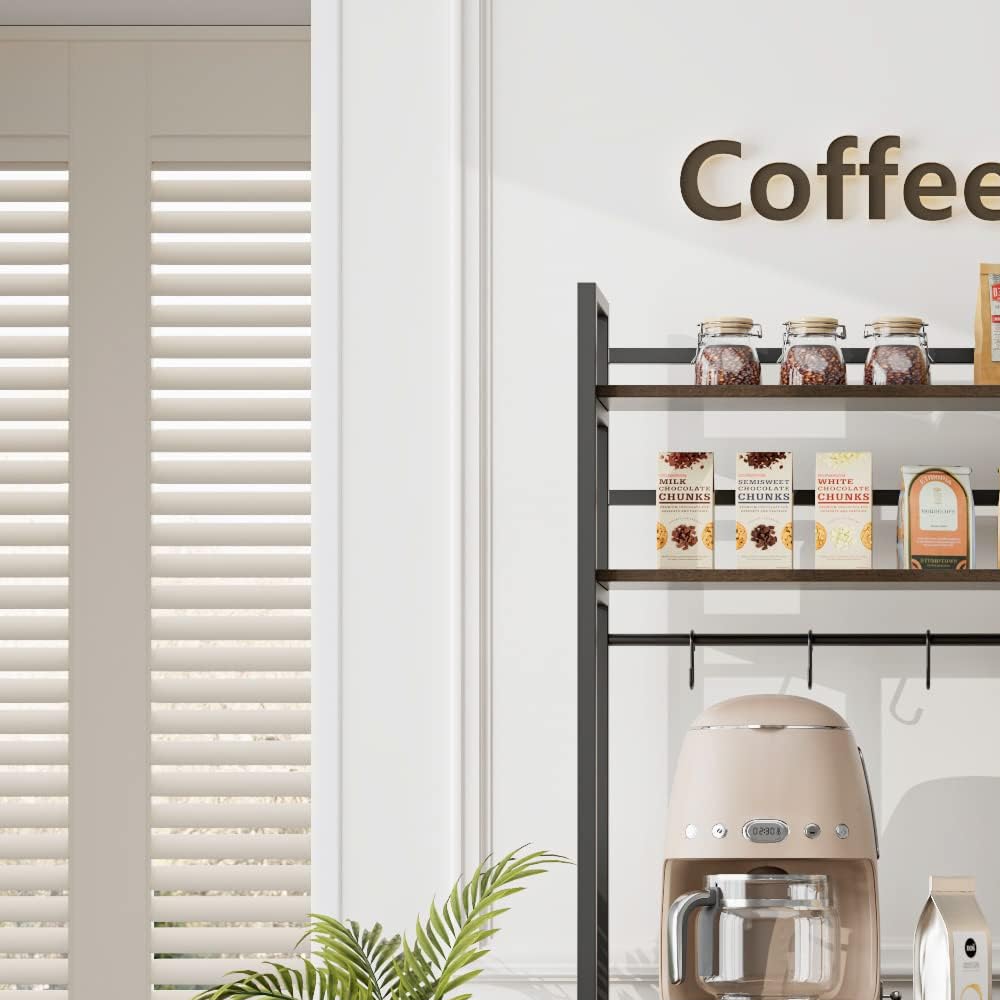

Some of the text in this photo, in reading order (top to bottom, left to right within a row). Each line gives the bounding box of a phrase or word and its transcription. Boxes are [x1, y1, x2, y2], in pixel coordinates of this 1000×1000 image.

[658, 493, 711, 501] CHUNKS
[738, 493, 790, 501] CHUNKS
[817, 493, 870, 501] CHUNKS
